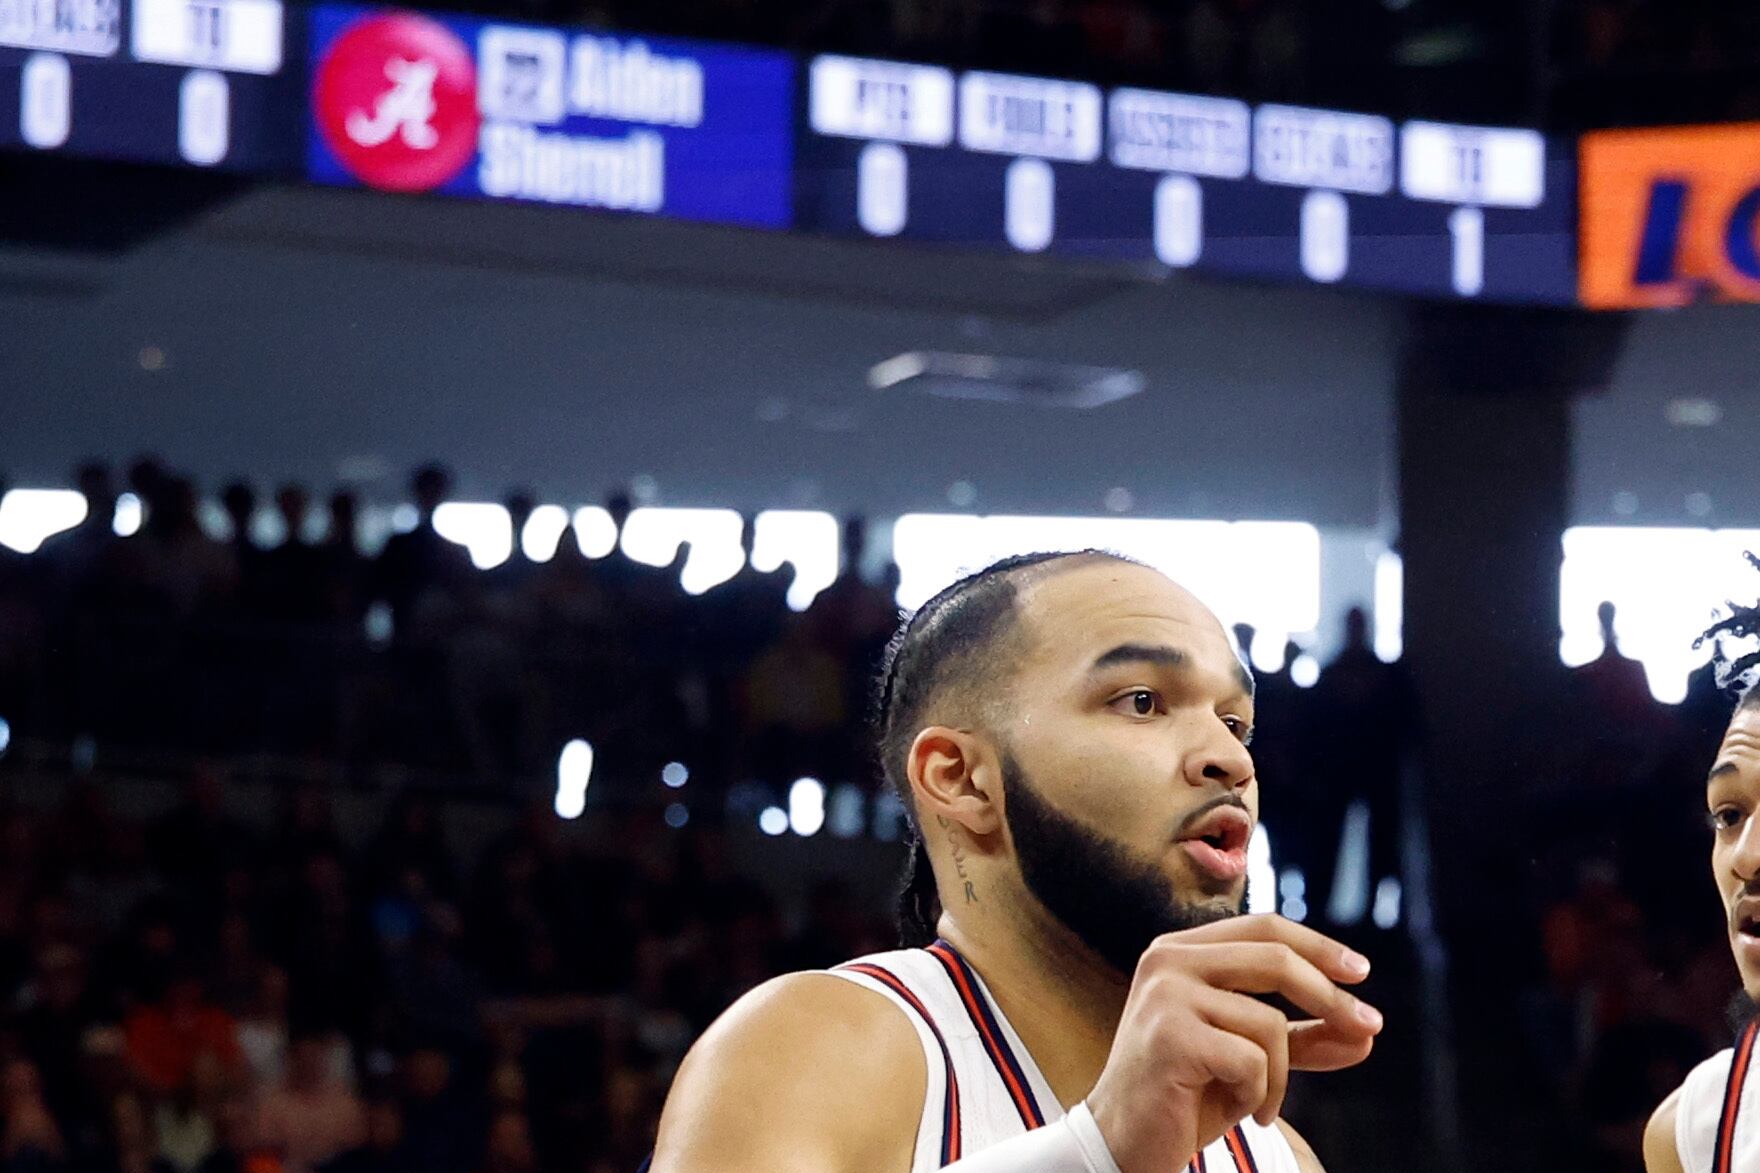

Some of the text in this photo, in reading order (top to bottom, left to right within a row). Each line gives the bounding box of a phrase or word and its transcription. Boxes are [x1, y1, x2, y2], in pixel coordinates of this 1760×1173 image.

[857, 142, 1484, 297] 0 0 0 0 1
